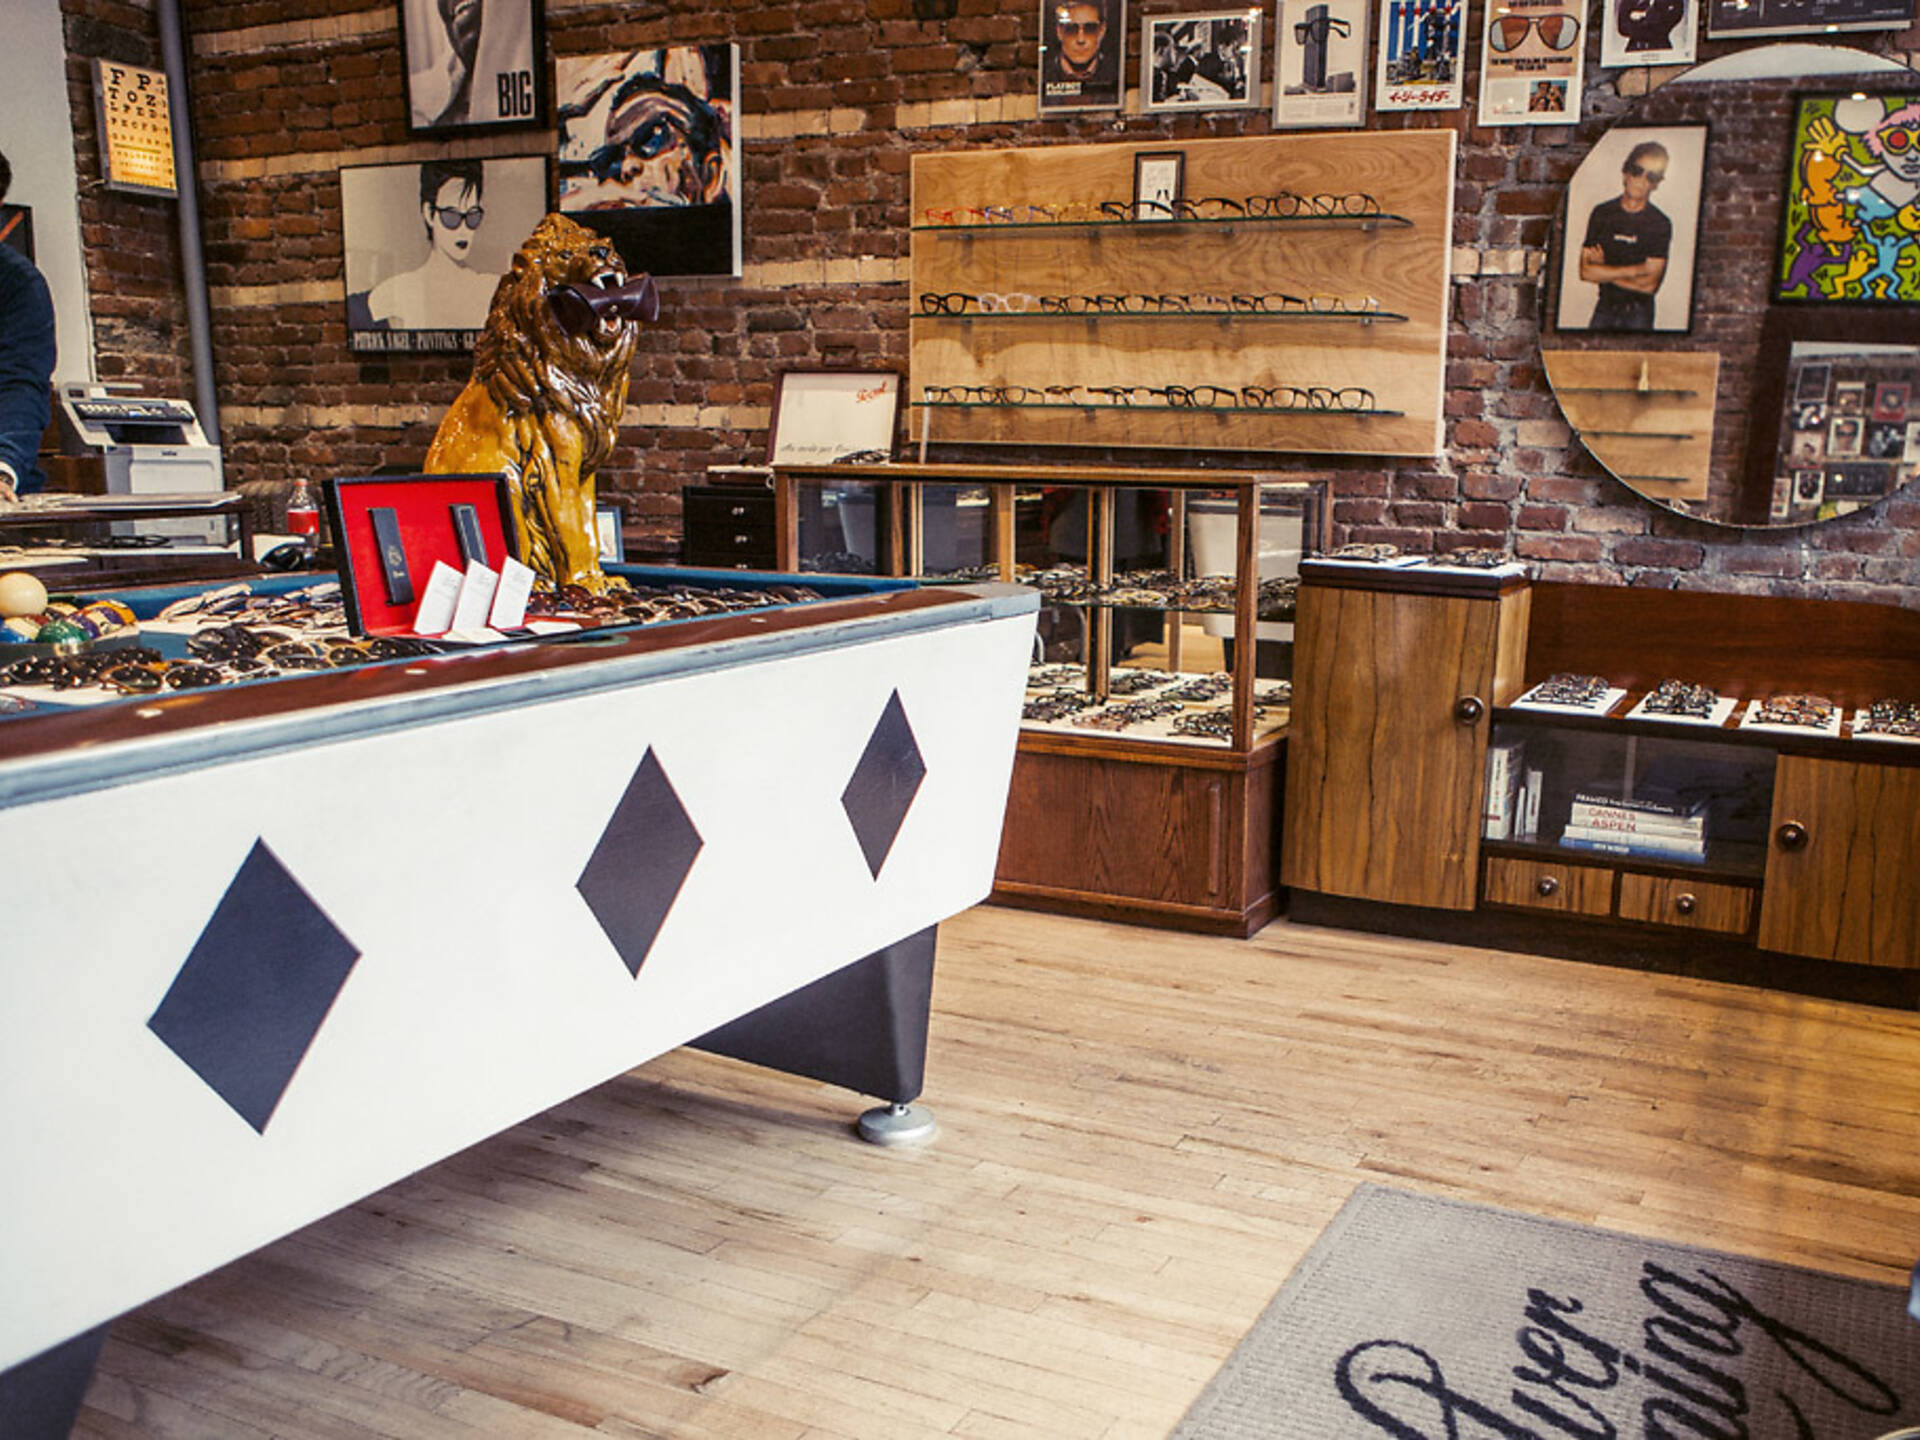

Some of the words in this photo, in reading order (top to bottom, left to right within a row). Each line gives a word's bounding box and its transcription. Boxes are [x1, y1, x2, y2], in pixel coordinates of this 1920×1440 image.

[497, 71, 531, 117] BIG
[1588, 807, 1636, 821] CANNES
[1592, 819, 1637, 833] ASPEN
